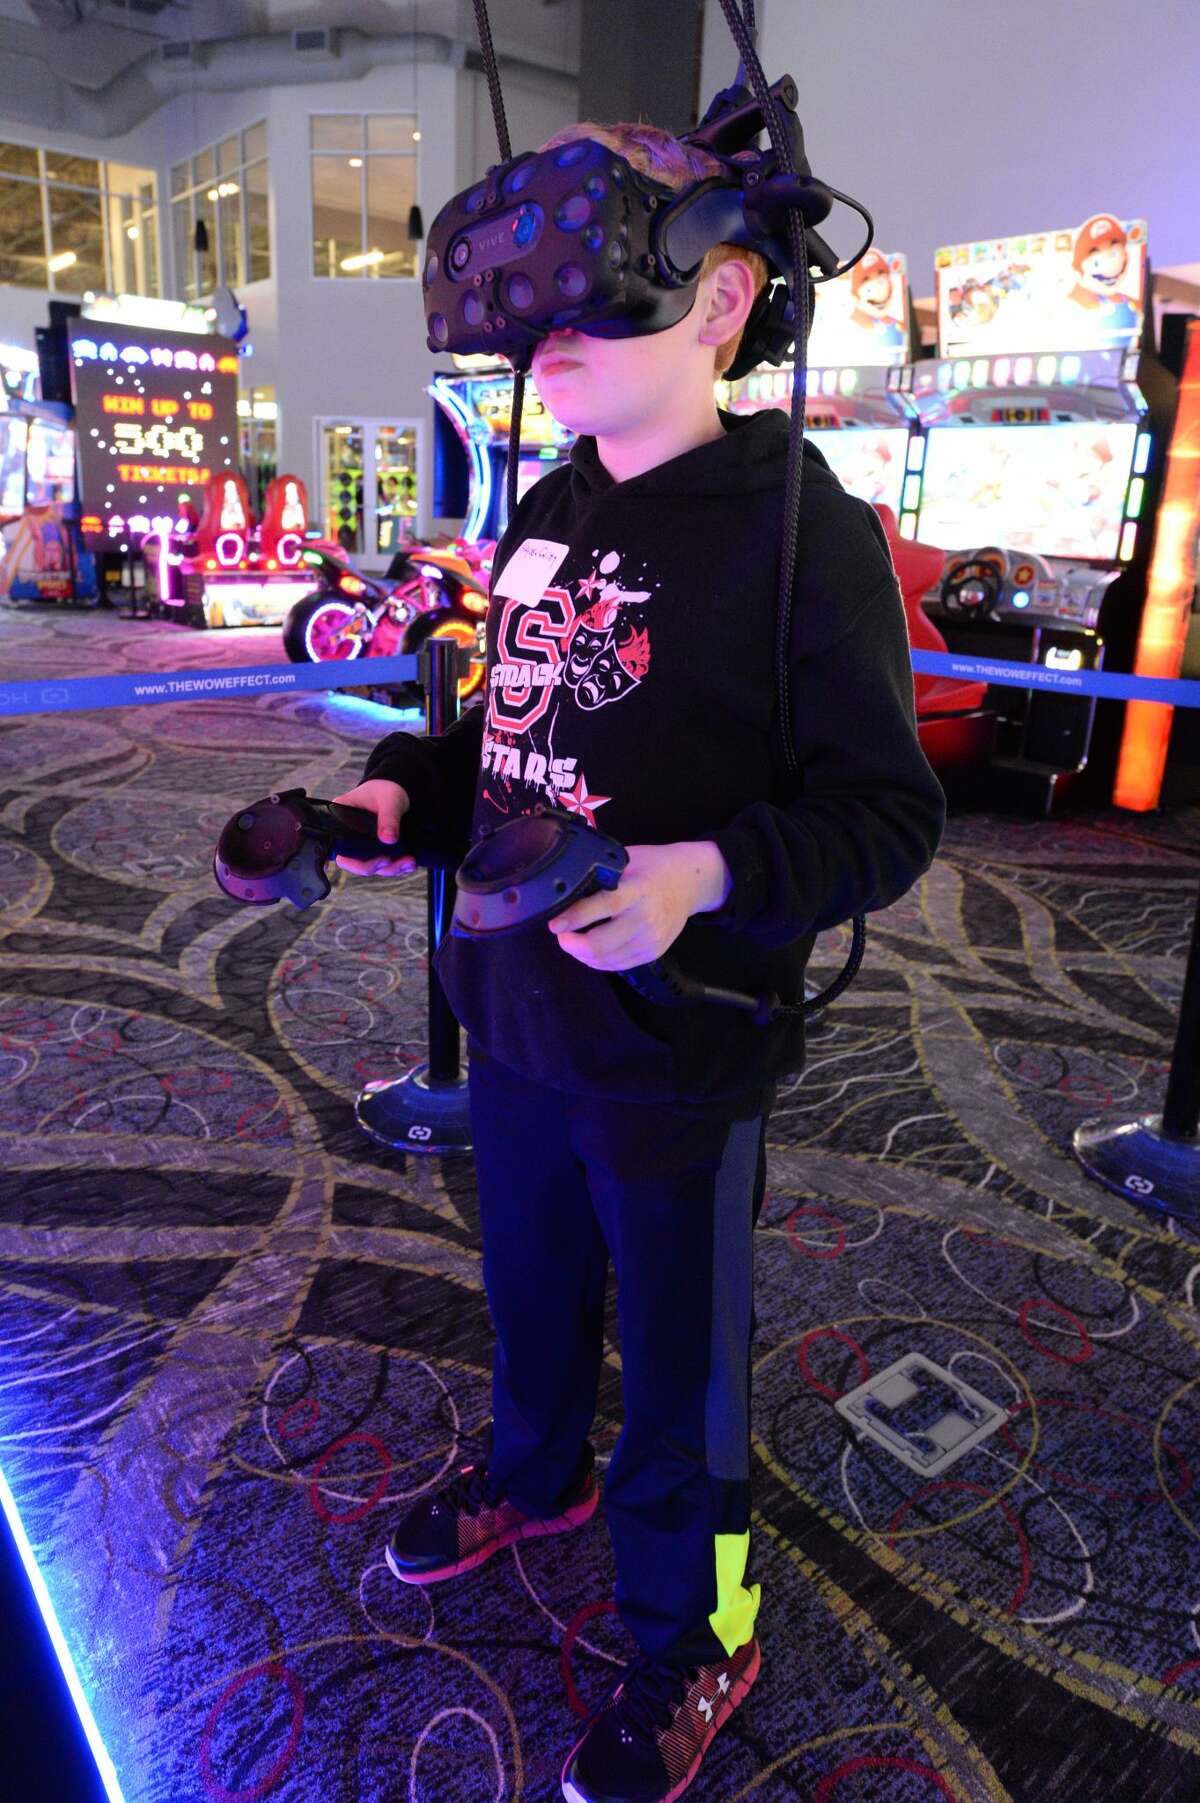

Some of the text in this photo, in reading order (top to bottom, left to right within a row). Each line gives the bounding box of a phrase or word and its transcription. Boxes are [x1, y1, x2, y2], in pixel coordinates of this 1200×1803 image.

[479, 232, 505, 251] VIVE
[103, 394, 214, 420] WIN UP TO
[114, 423, 203, 458] 500
[134, 674, 296, 696] www.THEWOWEFFECT.com
[951, 662, 1082, 687] www.THEWOWEFFECT.com
[481, 741, 578, 793] STARS
